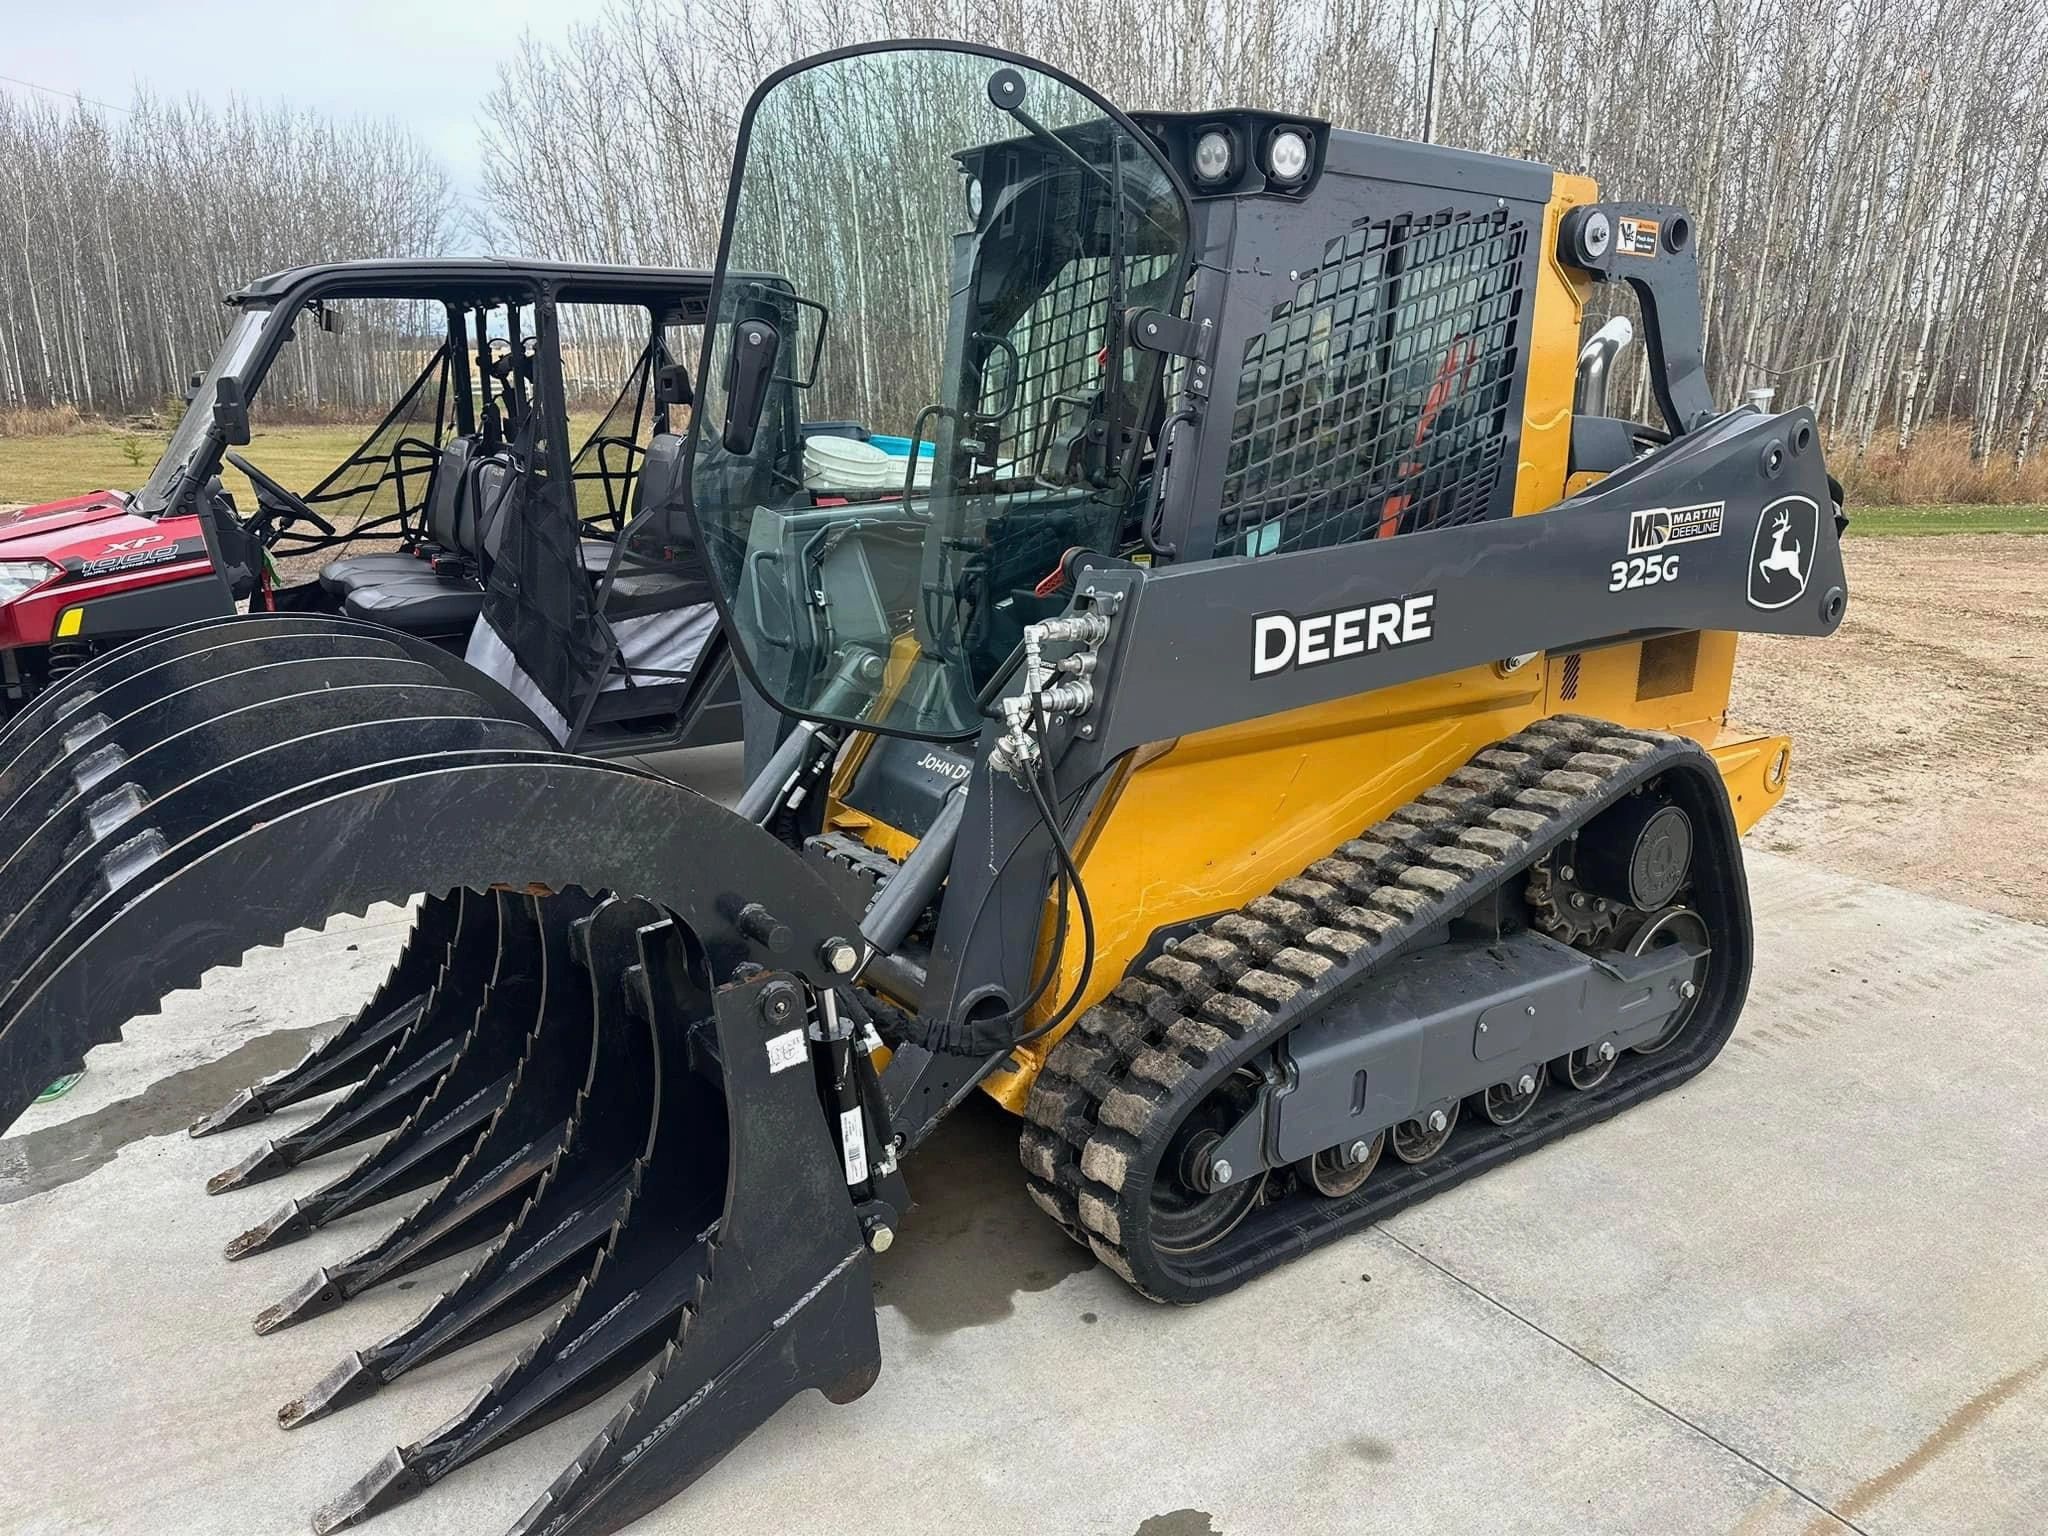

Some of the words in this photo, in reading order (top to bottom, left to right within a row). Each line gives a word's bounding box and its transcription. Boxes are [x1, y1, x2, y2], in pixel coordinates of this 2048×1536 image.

[1674, 507, 1721, 524] MARTIN
[1672, 521, 1719, 539] DEERLINE
[102, 535, 164, 554] XP
[82, 544, 179, 574] 1000
[1609, 555, 1680, 592] 325G
[1254, 595, 1434, 675] DEERE
[917, 752, 955, 777] JOHN
